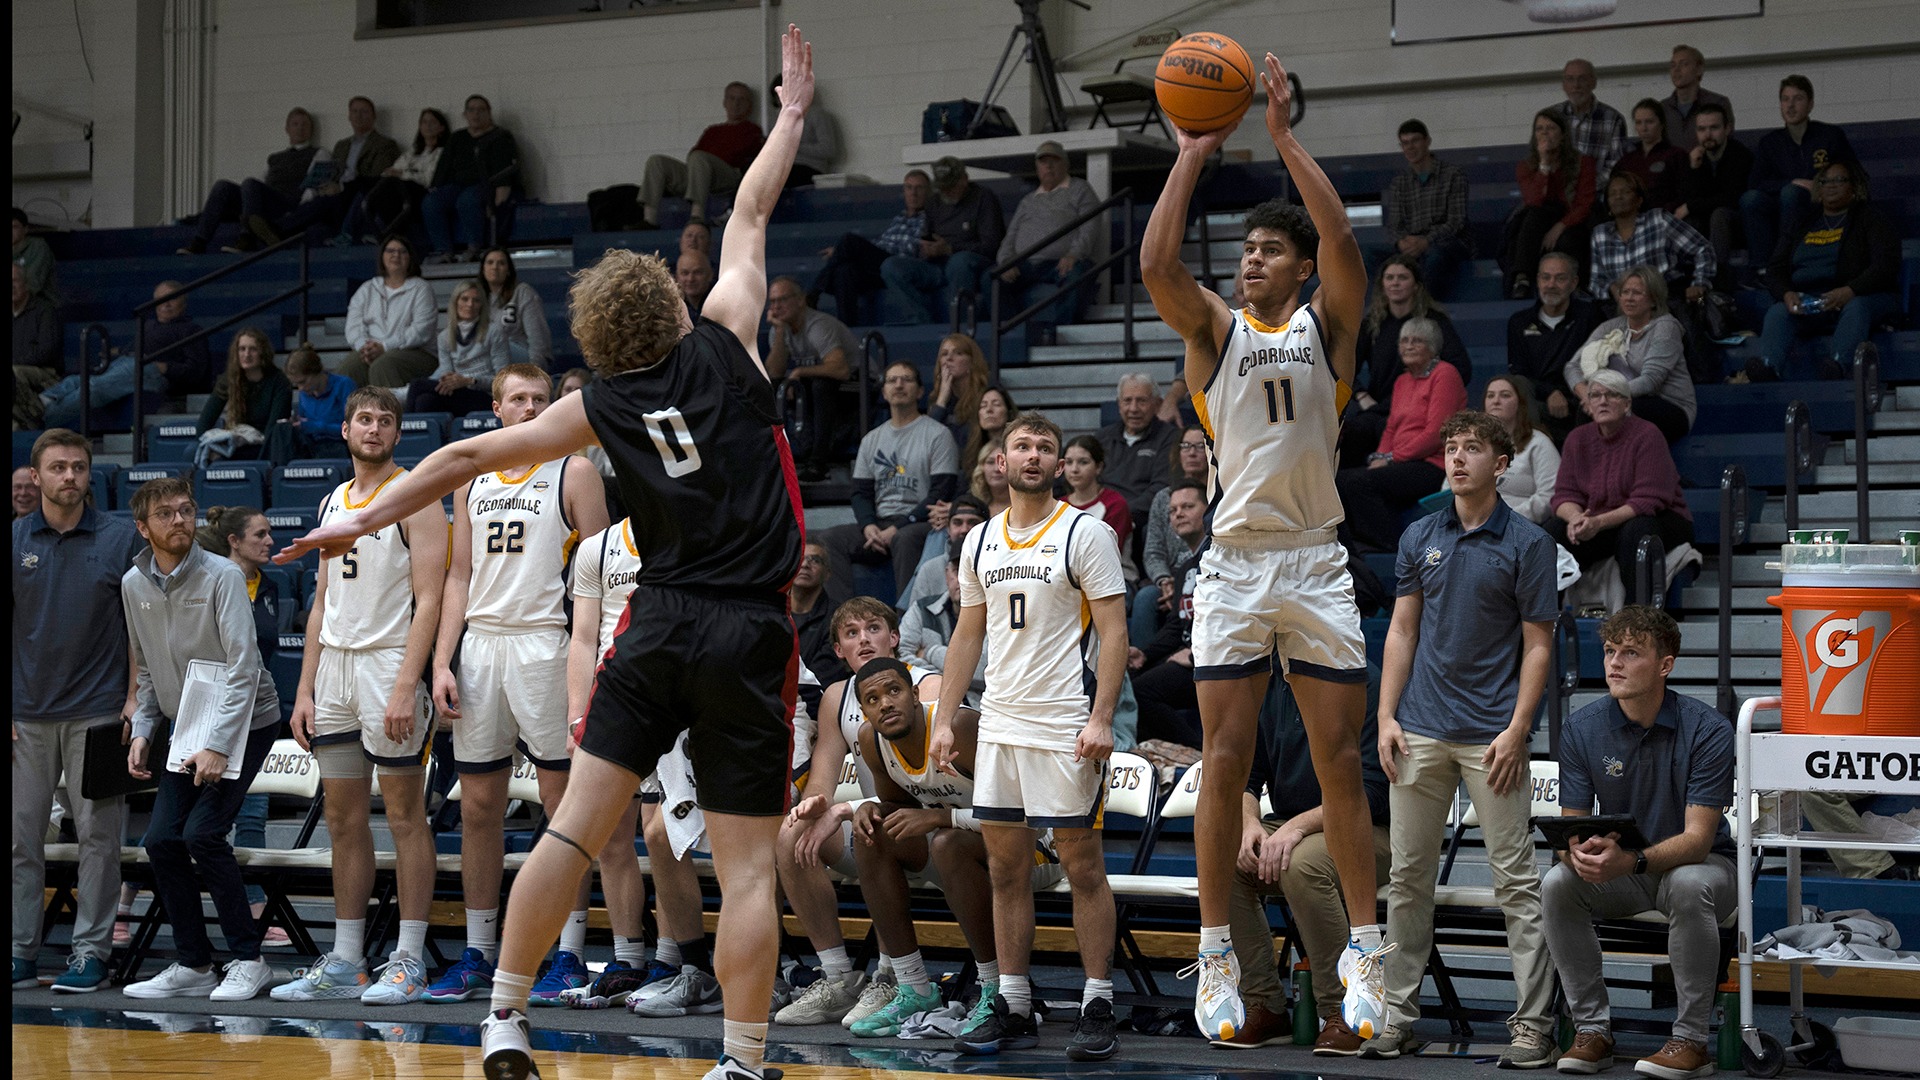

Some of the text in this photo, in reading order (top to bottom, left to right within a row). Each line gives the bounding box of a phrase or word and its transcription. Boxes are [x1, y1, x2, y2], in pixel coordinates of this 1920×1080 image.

[1164, 56, 1224, 83] Wilson
[1238, 346, 1315, 377] CDARVILLE
[1261, 376, 1296, 425] 11
[160, 426, 197, 436] RESERVED
[401, 420, 427, 430] ERVED
[641, 406, 702, 478] 0
[129, 471, 167, 481] RESERVED
[206, 470, 246, 480] RESERVED
[284, 468, 324, 478] RESERVED
[476, 498, 541, 515] CEDARVILLE
[266, 516, 302, 526] SERVED
[486, 520, 526, 556] 22
[341, 547, 359, 580] 5
[984, 565, 1052, 589] CEDARVILLE
[1008, 591, 1027, 631] 0
[1815, 618, 1859, 668] G
[262, 753, 314, 776] CKETS
